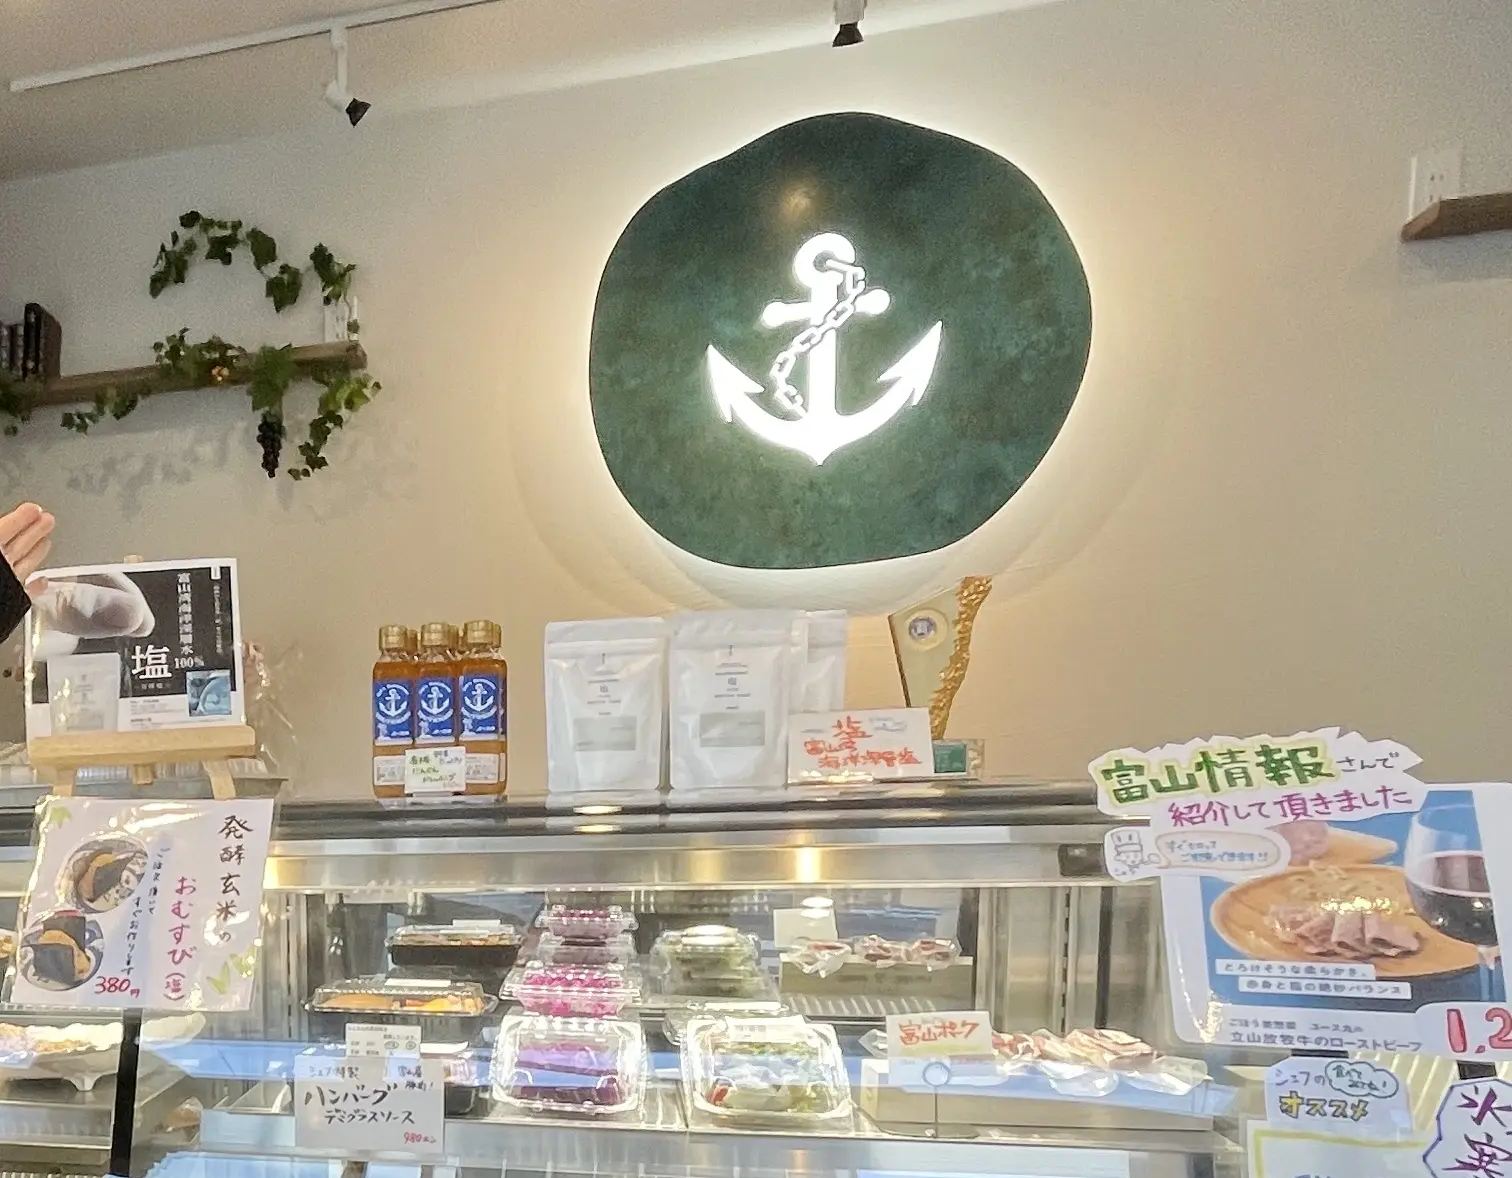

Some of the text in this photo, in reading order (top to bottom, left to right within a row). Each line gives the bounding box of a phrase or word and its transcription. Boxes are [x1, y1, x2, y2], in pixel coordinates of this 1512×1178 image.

[131, 644, 173, 680] 塩
[174, 655, 205, 669] 100%
[831, 715, 874, 739] 塩
[1100, 742, 1400, 804] 富山情報さんで
[1167, 785, 1413, 828] 紹介して頂きました
[215, 814, 254, 943] 発酵玄米の
[94, 975, 140, 998] 380円
[1230, 1031, 1423, 1053] 立山放牧牛のローストビーフ
[1274, 1067, 1326, 1087] シェフの
[304, 1082, 398, 1107] ハンバーグ
[1278, 1089, 1370, 1122] オススメ
[323, 1107, 416, 1125] デミグラスソース
